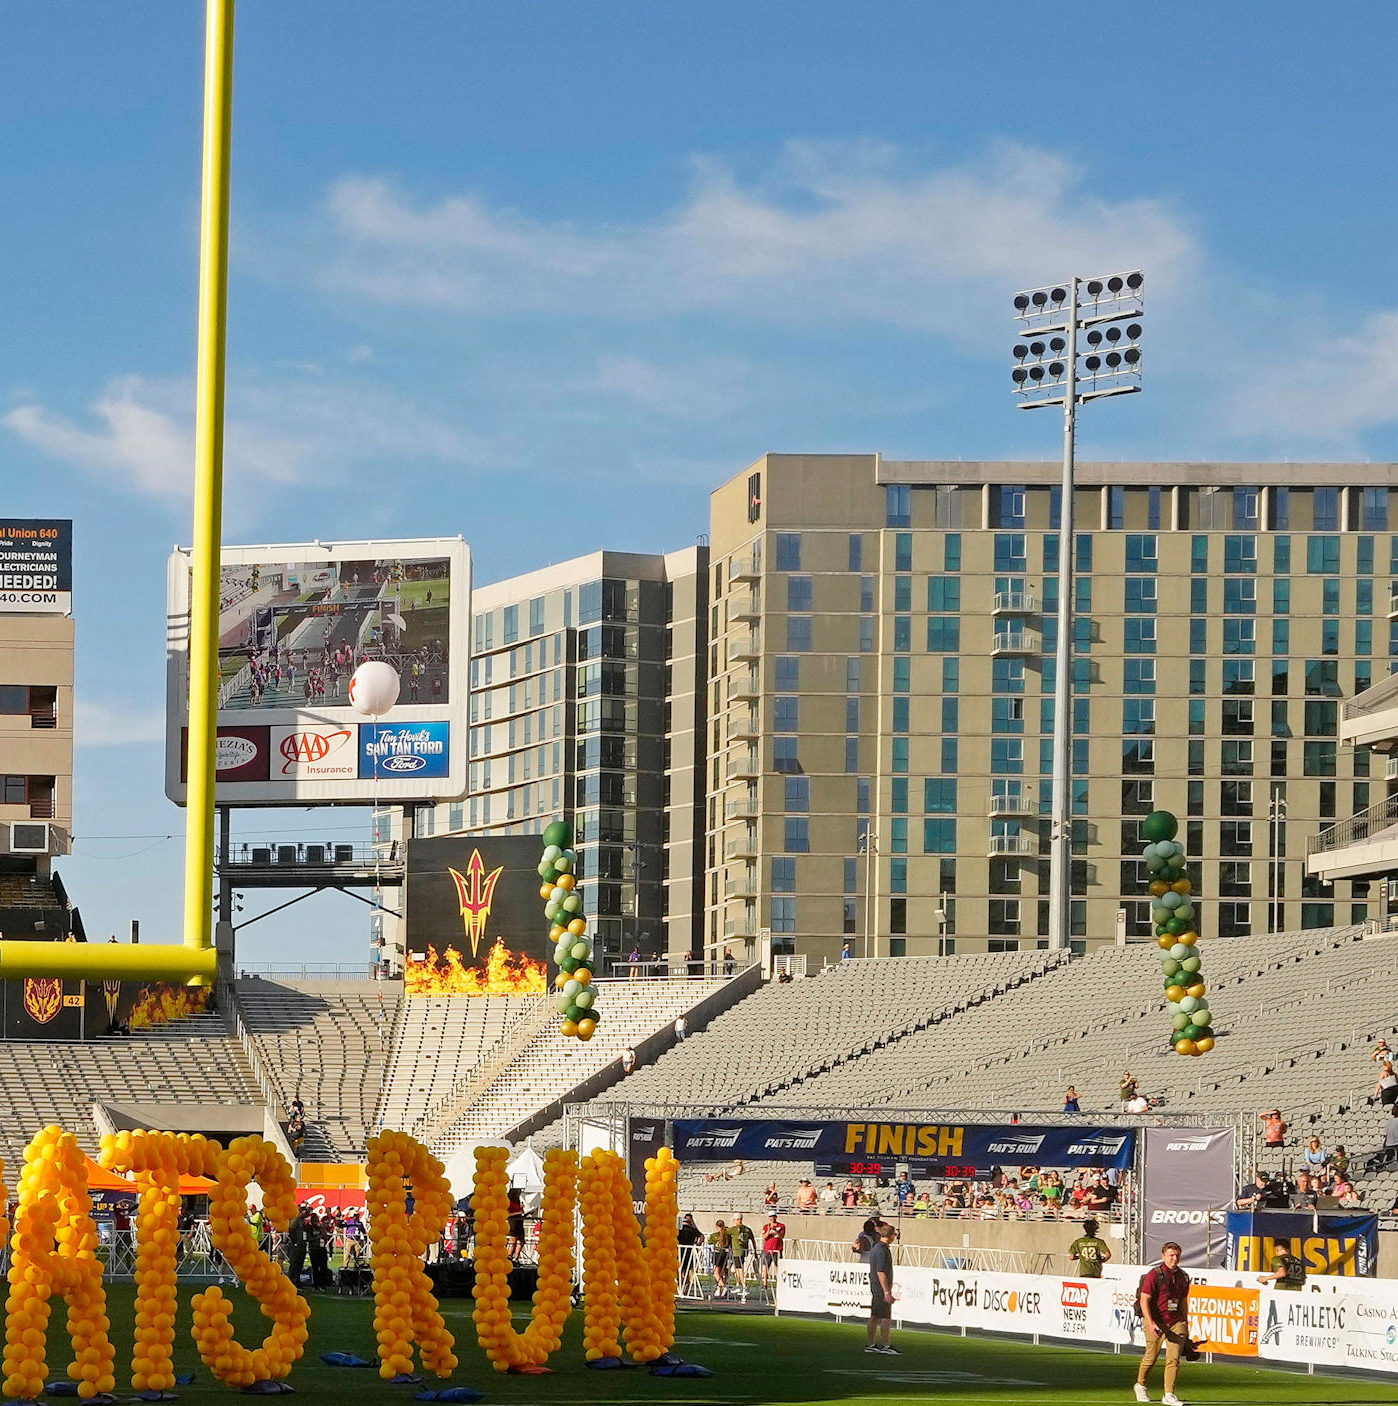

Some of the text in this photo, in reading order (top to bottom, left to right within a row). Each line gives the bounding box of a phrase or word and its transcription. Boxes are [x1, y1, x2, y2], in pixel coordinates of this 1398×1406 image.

[8, 528, 37, 538] Union
[39, 529, 58, 538] 640
[32, 540, 52, 548] Dignity
[216, 740, 254, 753] EZIA'S
[285, 732, 327, 762] AAA
[366, 741, 443, 756] SAN TAN FORD
[307, 765, 353, 775] Insurance
[390, 758, 418, 769] Ford
[68, 997, 80, 1005] 42
[686, 1137, 737, 1148] PAT'S RUN
[764, 1138, 817, 1149] PAT'S RUN
[845, 1124, 964, 1157] FINISH
[1166, 1142, 1208, 1151] PAT'S RUN
[987, 1143, 1038, 1153] PAT'S RUN
[1067, 1144, 1119, 1156] PAT'S RUN
[1151, 1210, 1226, 1224] BROOKS
[365, 1129, 679, 1381] RUN
[1082, 1247, 1097, 1260] 42
[830, 1270, 870, 1285] GILA RIVE
[1287, 1264, 1302, 1280] 42
[932, 1278, 978, 1315] PayPal
[983, 1289, 1041, 1314] DISCOVER
[1188, 1297, 1244, 1317] RIZONA'S
[1356, 1303, 1387, 1319] CASINO
[1063, 1308, 1087, 1322] NEWS
[1288, 1304, 1346, 1329] ATHLETIC
